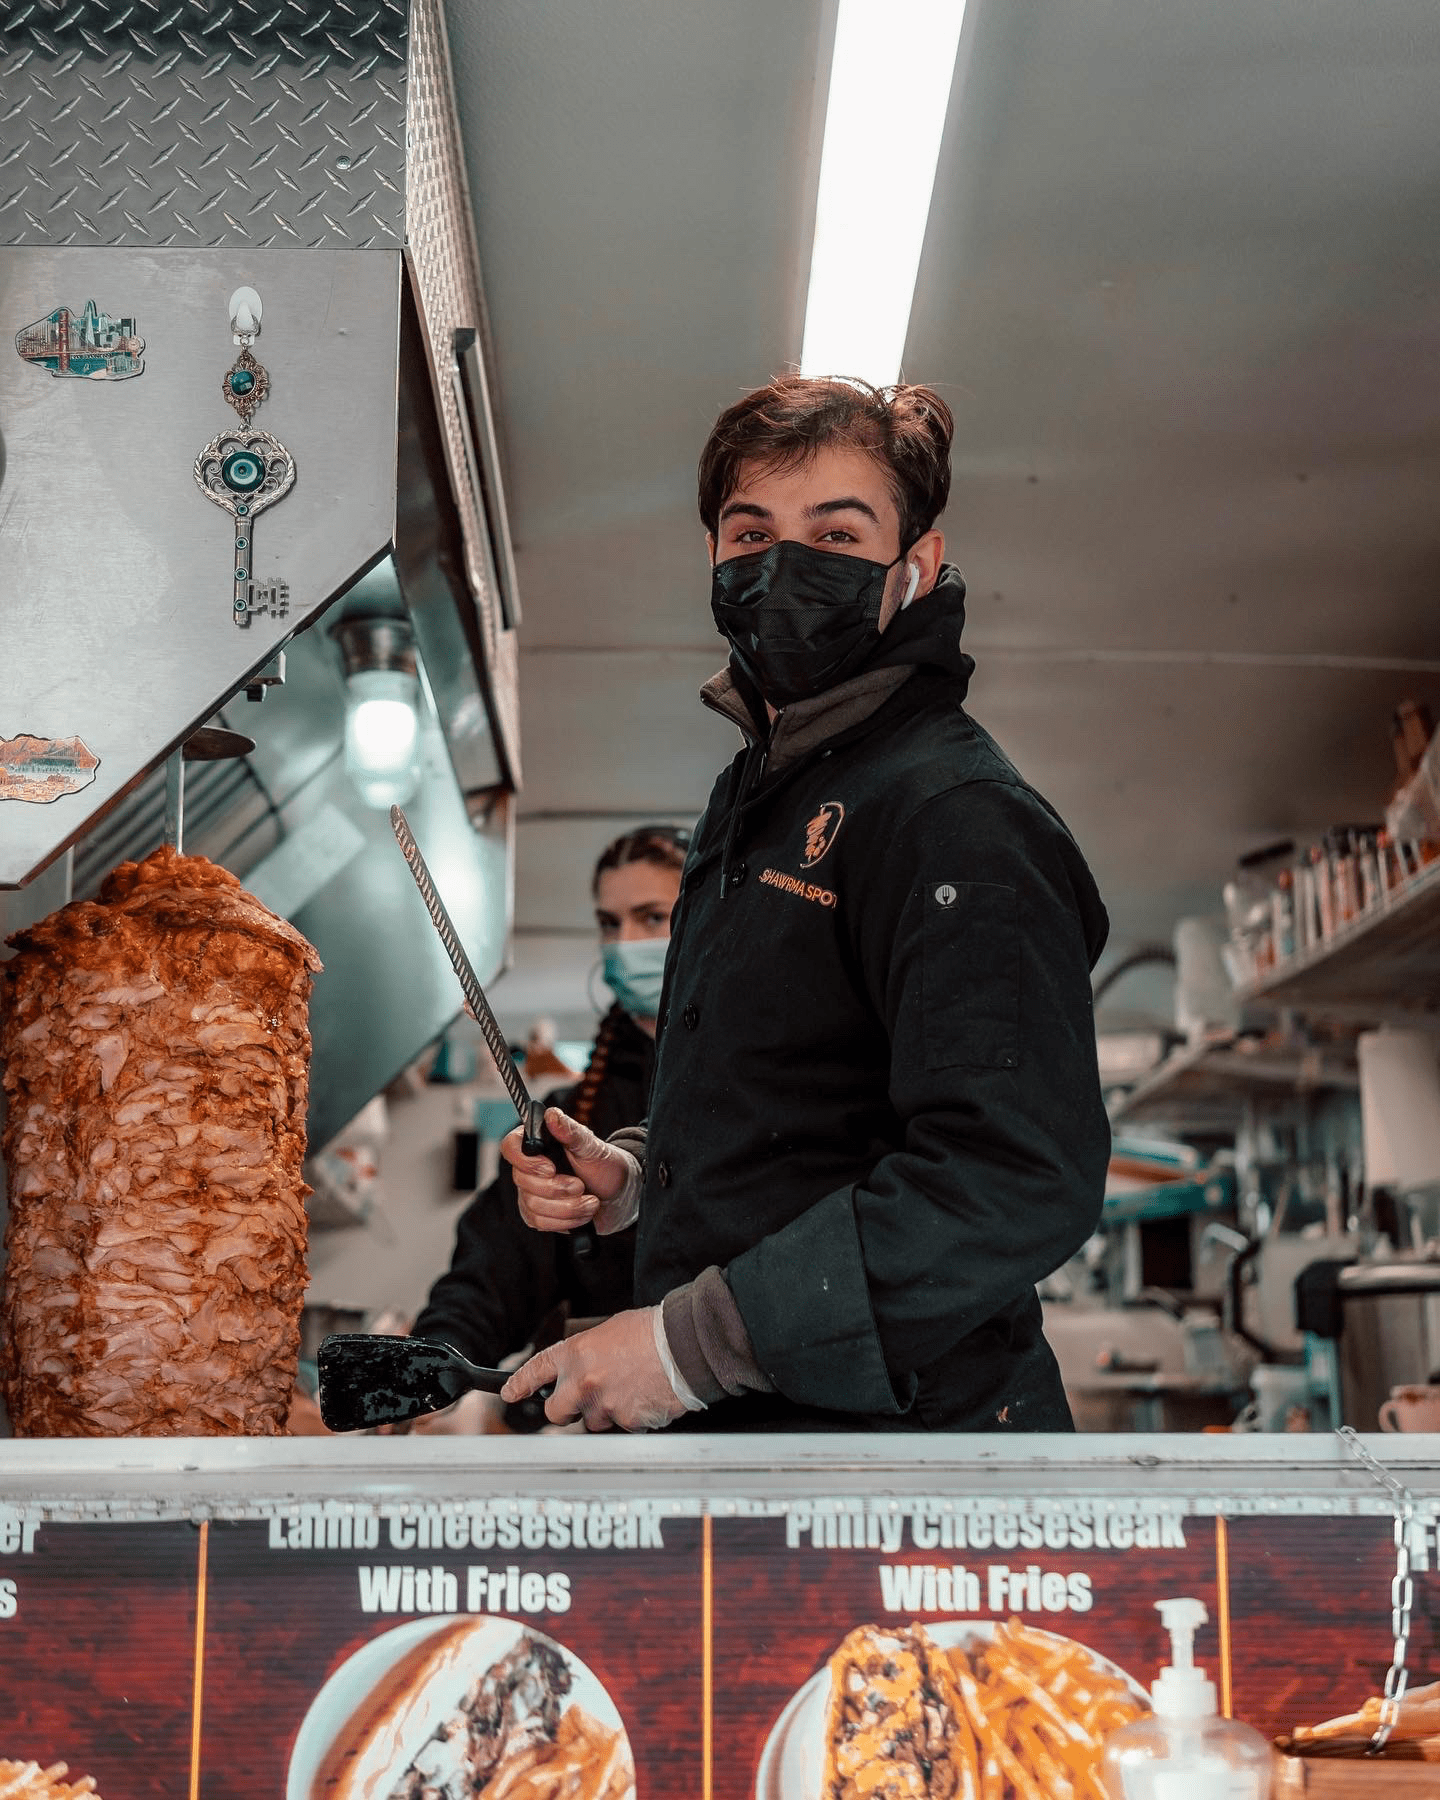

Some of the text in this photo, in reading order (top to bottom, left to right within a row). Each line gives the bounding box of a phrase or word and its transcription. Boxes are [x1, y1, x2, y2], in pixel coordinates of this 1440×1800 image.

[269, 1515, 664, 1549] Lamb Cheesesteak
[786, 1513, 1187, 1553] Philly Cheesesteak
[358, 1565, 571, 1613] With Fries
[879, 1565, 1093, 1612] With Fries
